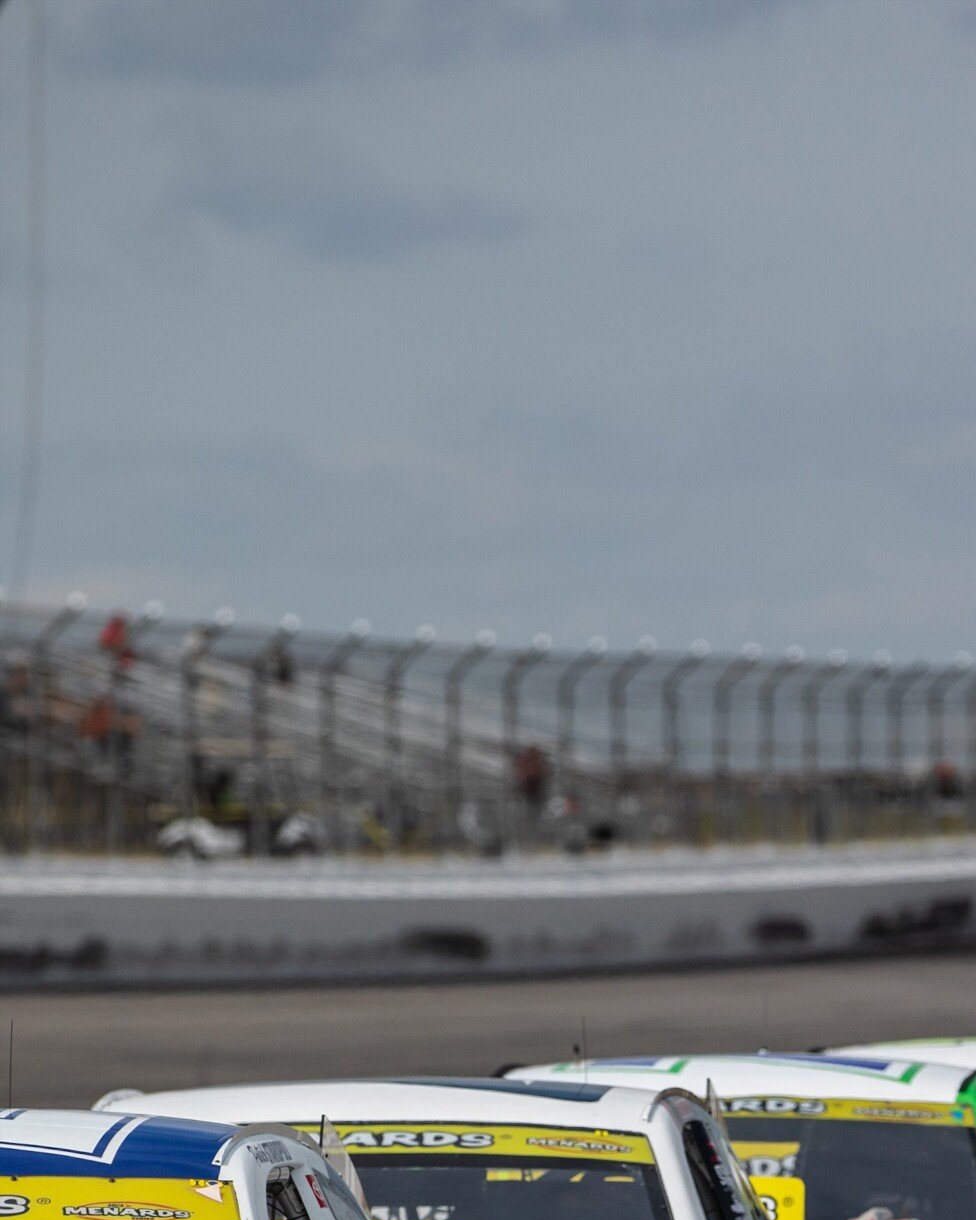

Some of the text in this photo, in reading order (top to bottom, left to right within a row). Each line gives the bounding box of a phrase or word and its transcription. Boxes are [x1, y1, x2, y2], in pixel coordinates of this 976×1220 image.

[308, 1130, 494, 1149] ARDS
[526, 1137, 632, 1153] MENARDS
[62, 1206, 191, 1219] MENARDS
